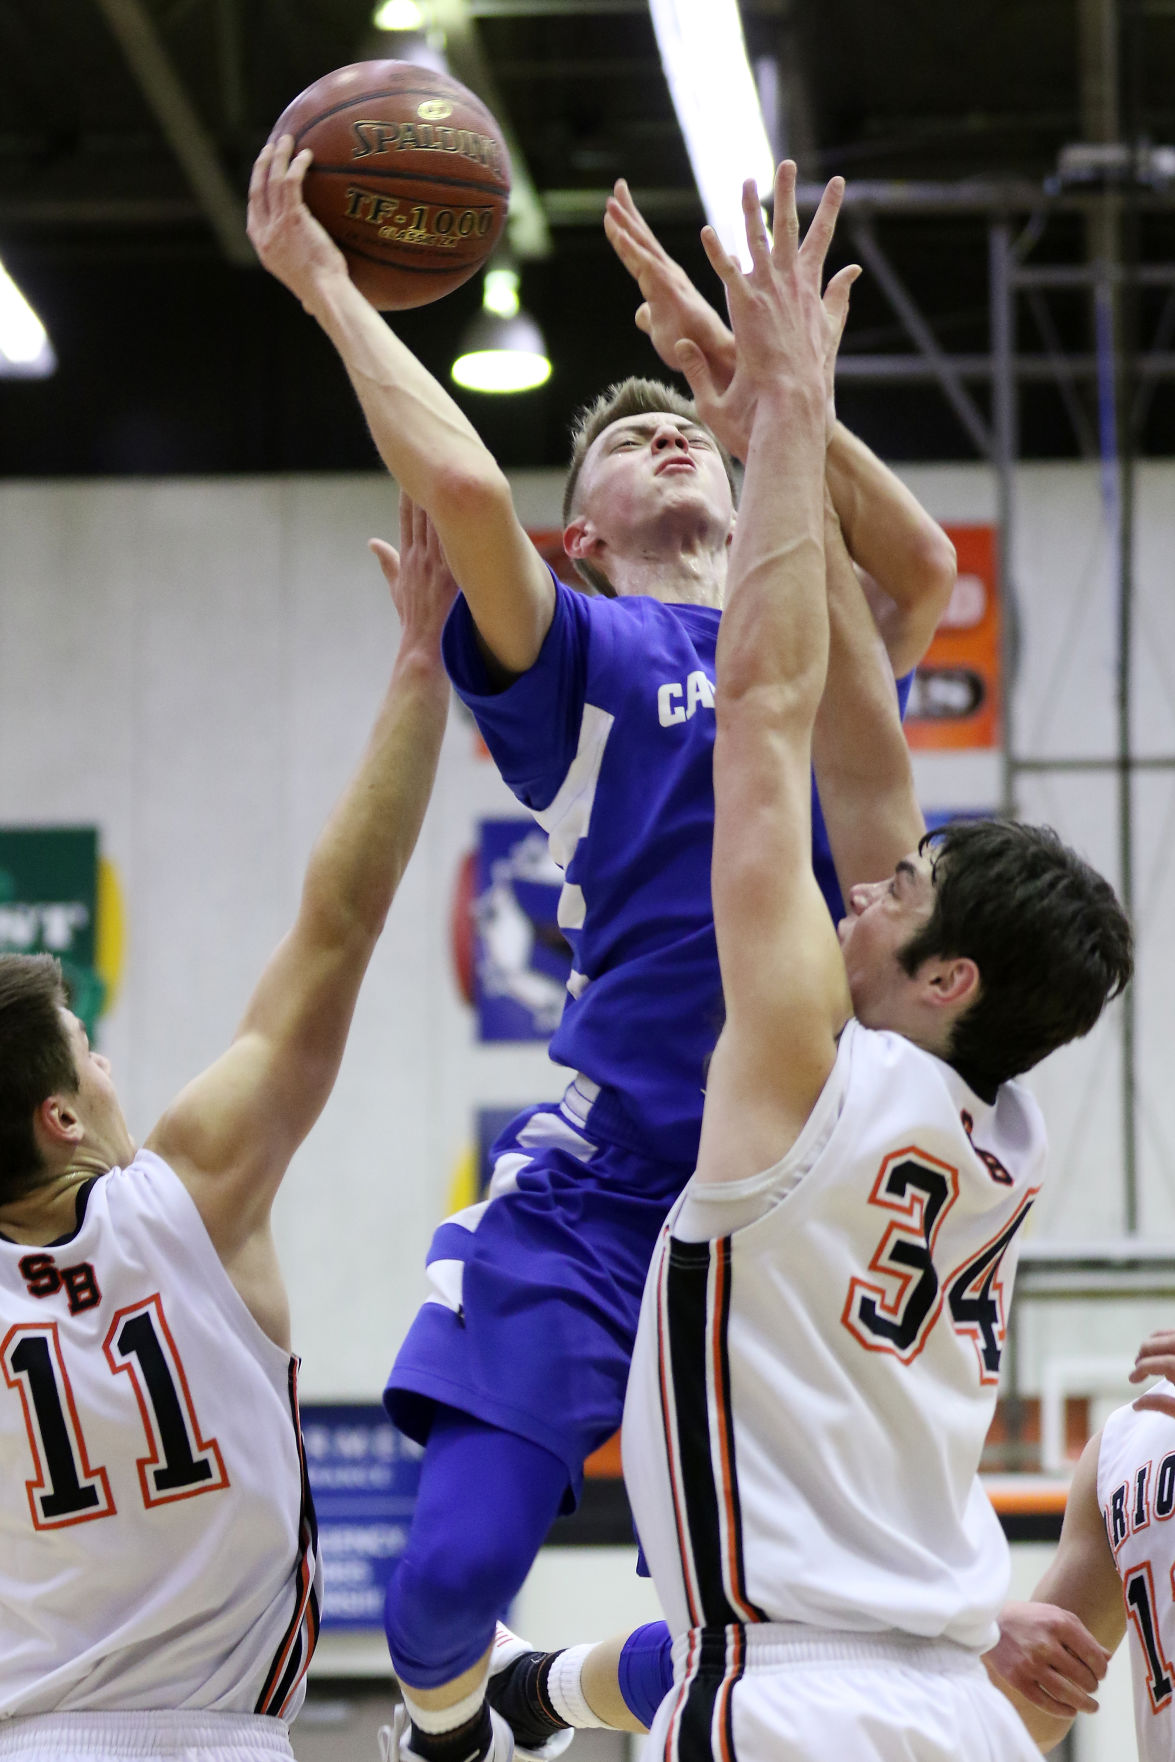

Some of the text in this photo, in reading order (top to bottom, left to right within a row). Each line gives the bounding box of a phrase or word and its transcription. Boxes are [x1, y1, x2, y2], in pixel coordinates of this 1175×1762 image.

[345, 186, 493, 238] TF-1000
[658, 670, 716, 728] CA
[18, 1253, 102, 1317] SB
[841, 1145, 1043, 1386] 34
[0, 1292, 230, 1531] 11
